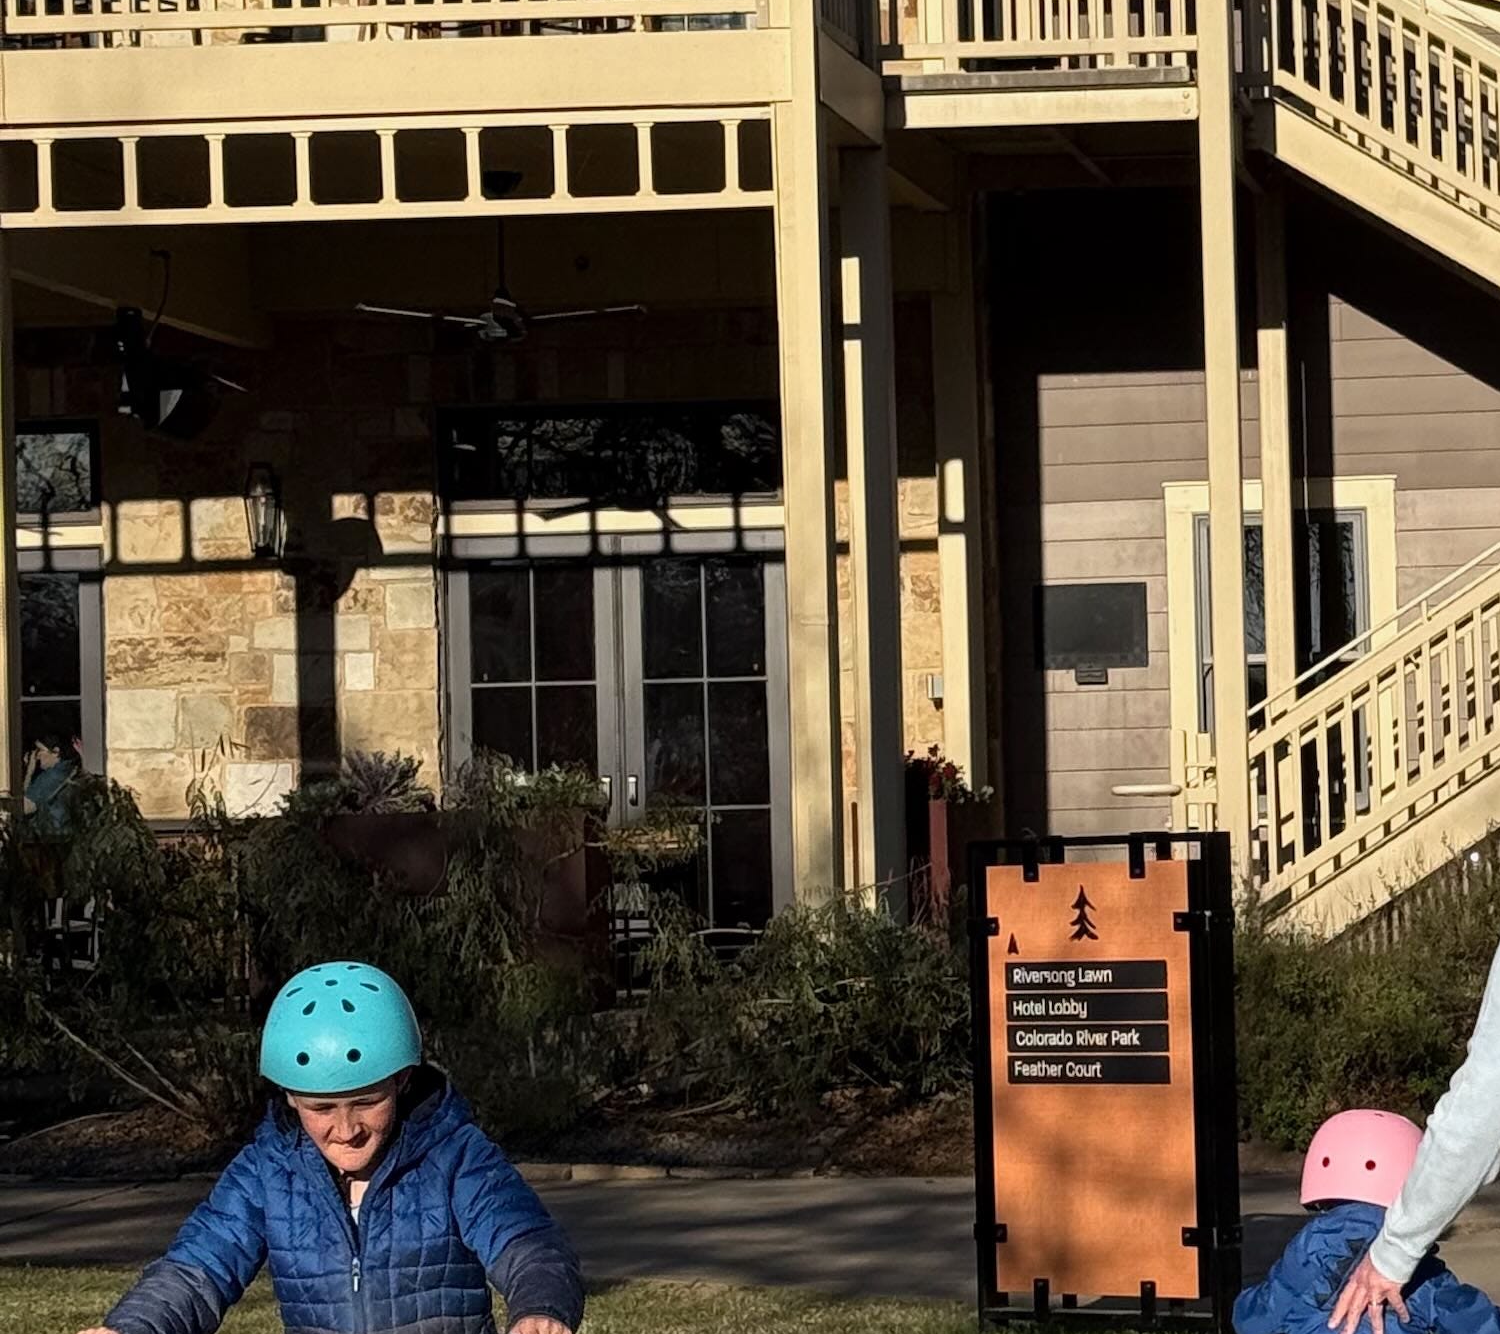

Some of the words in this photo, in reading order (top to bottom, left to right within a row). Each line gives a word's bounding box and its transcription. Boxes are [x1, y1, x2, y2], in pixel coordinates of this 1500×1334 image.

[1012, 967, 1076, 987] Riversong
[1078, 967, 1113, 983] Lawn
[1012, 998, 1046, 1016] Hotel
[1048, 998, 1088, 1018] Lobby
[1015, 1029, 1073, 1046] Colorado
[1076, 1029, 1109, 1046] River
[1111, 1028, 1141, 1046] Park
[1014, 1060, 1063, 1077] Feather
[1066, 1061, 1102, 1078] Court
